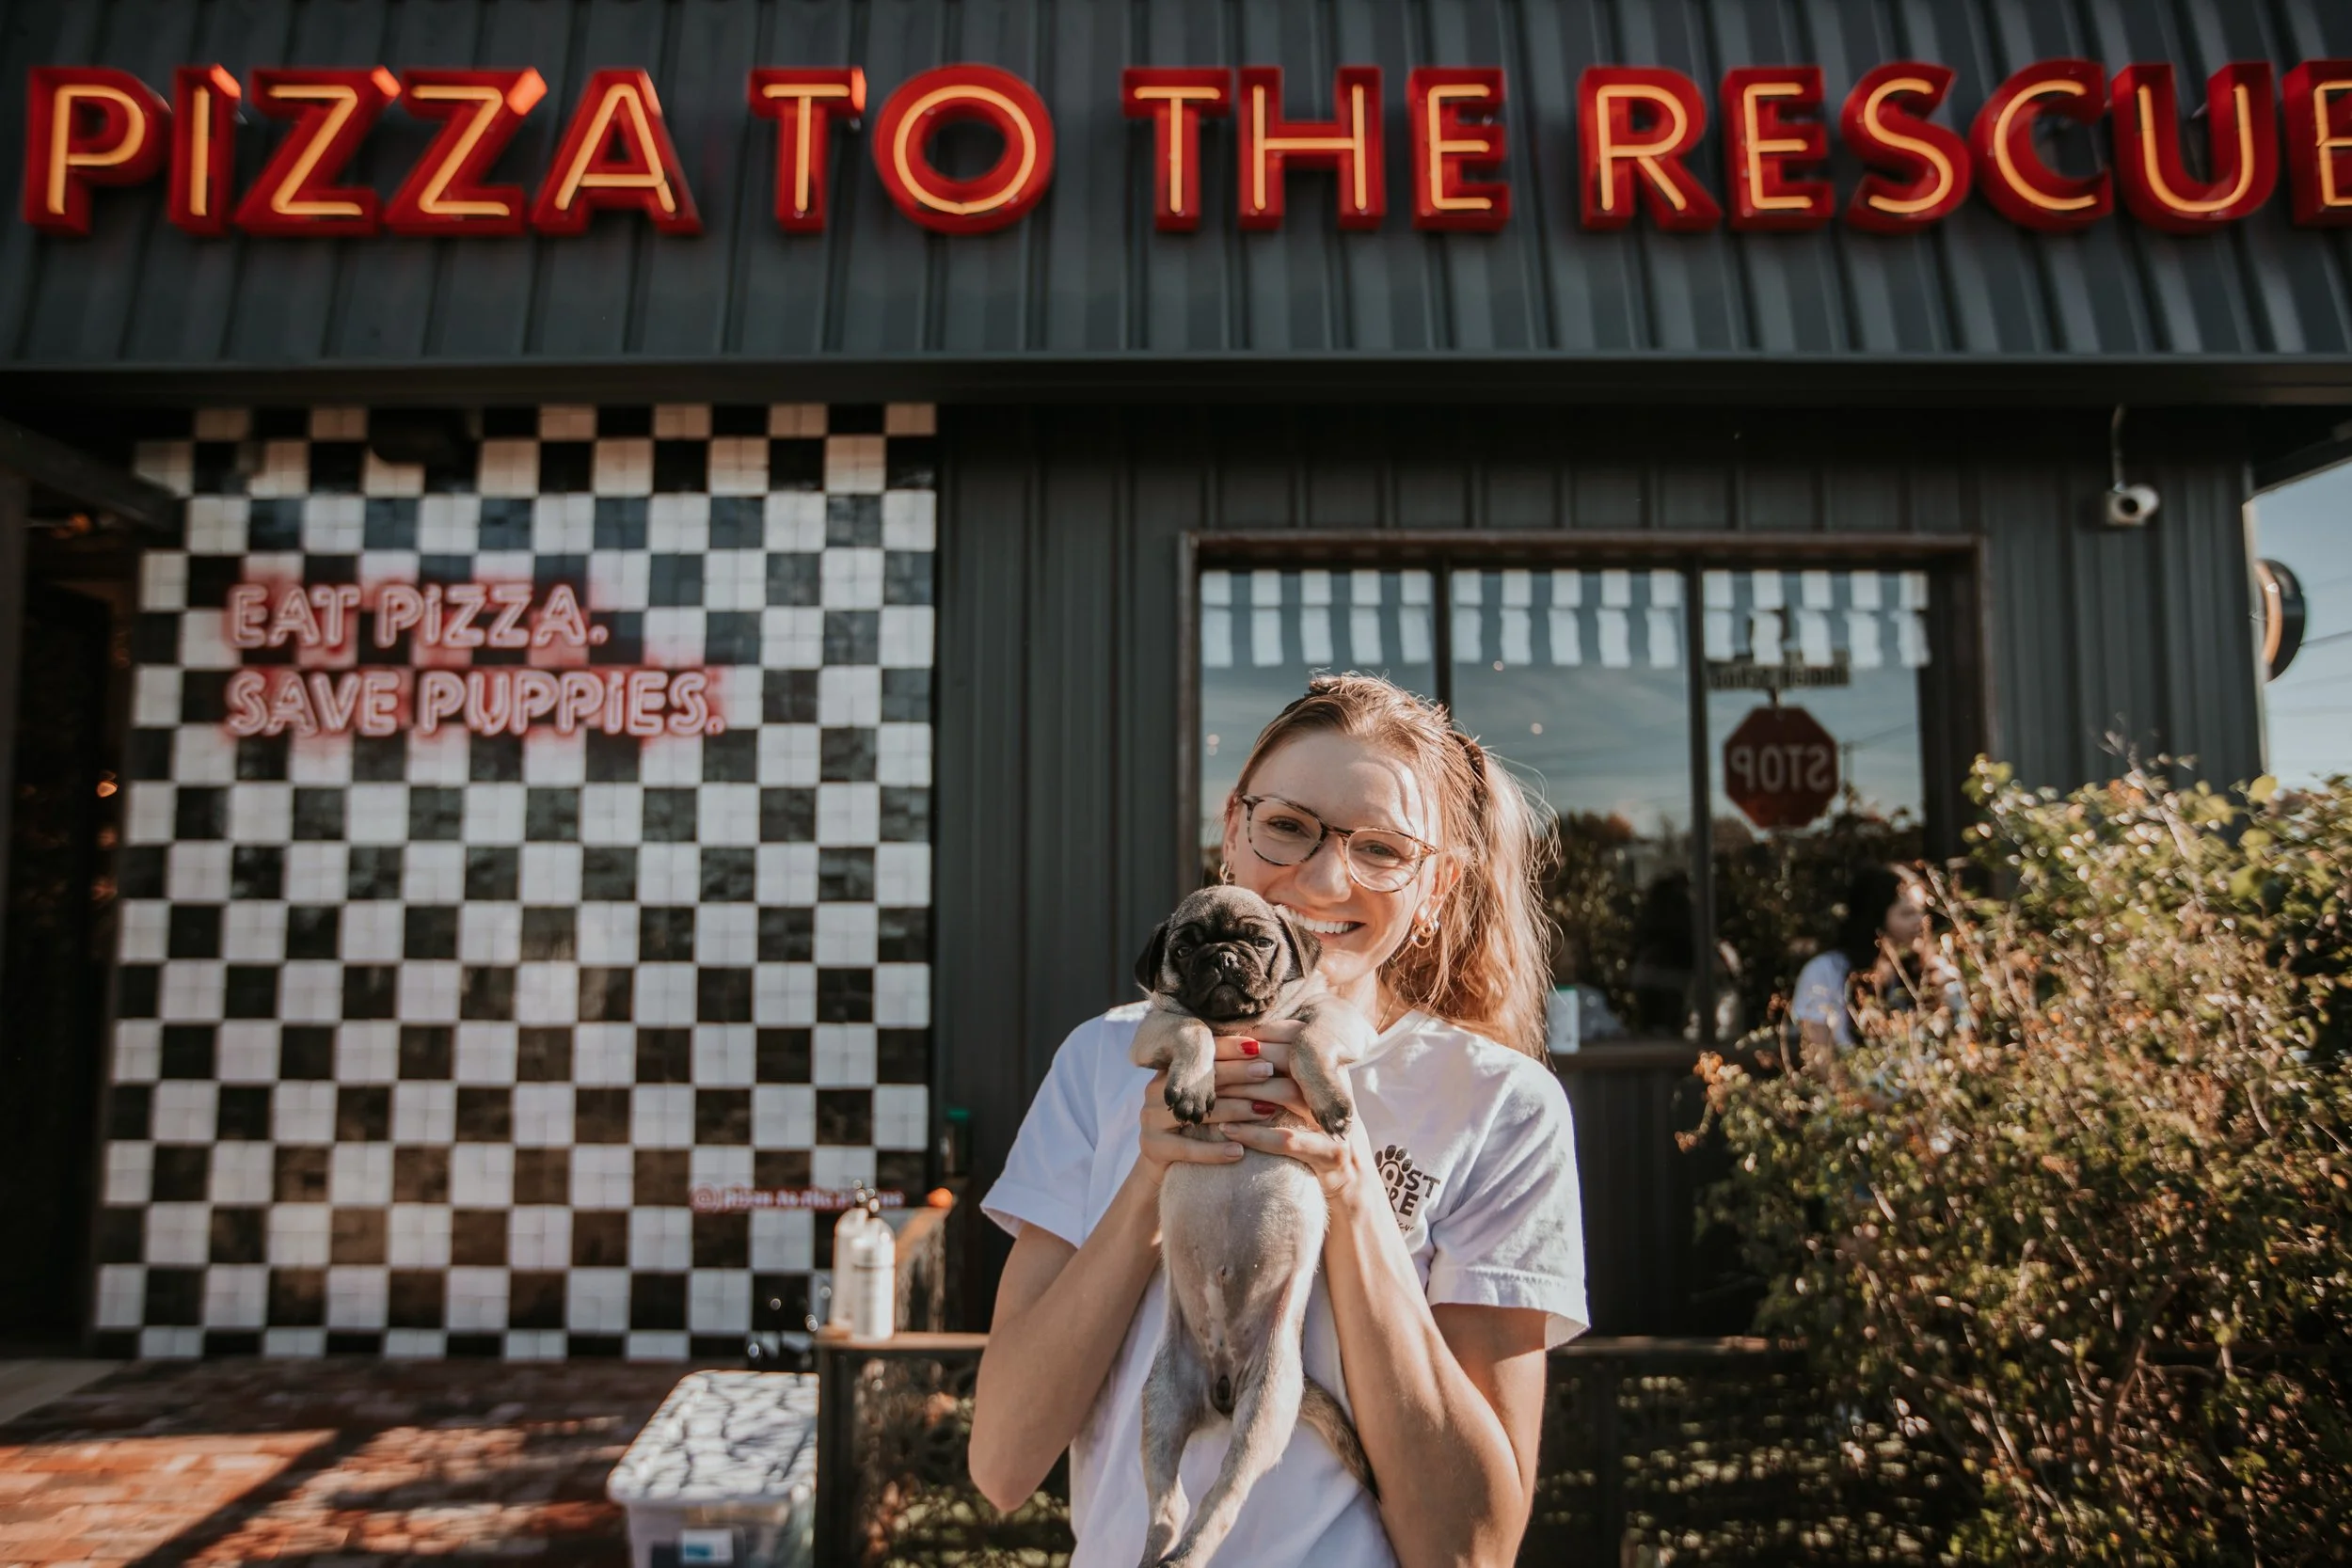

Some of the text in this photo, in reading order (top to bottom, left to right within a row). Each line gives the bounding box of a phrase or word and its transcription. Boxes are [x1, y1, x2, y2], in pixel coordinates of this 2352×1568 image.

[23, 57, 2352, 236] PIZZA TO THE RESCUE
[230, 583, 361, 648] EAT
[226, 670, 402, 737] SAVE
